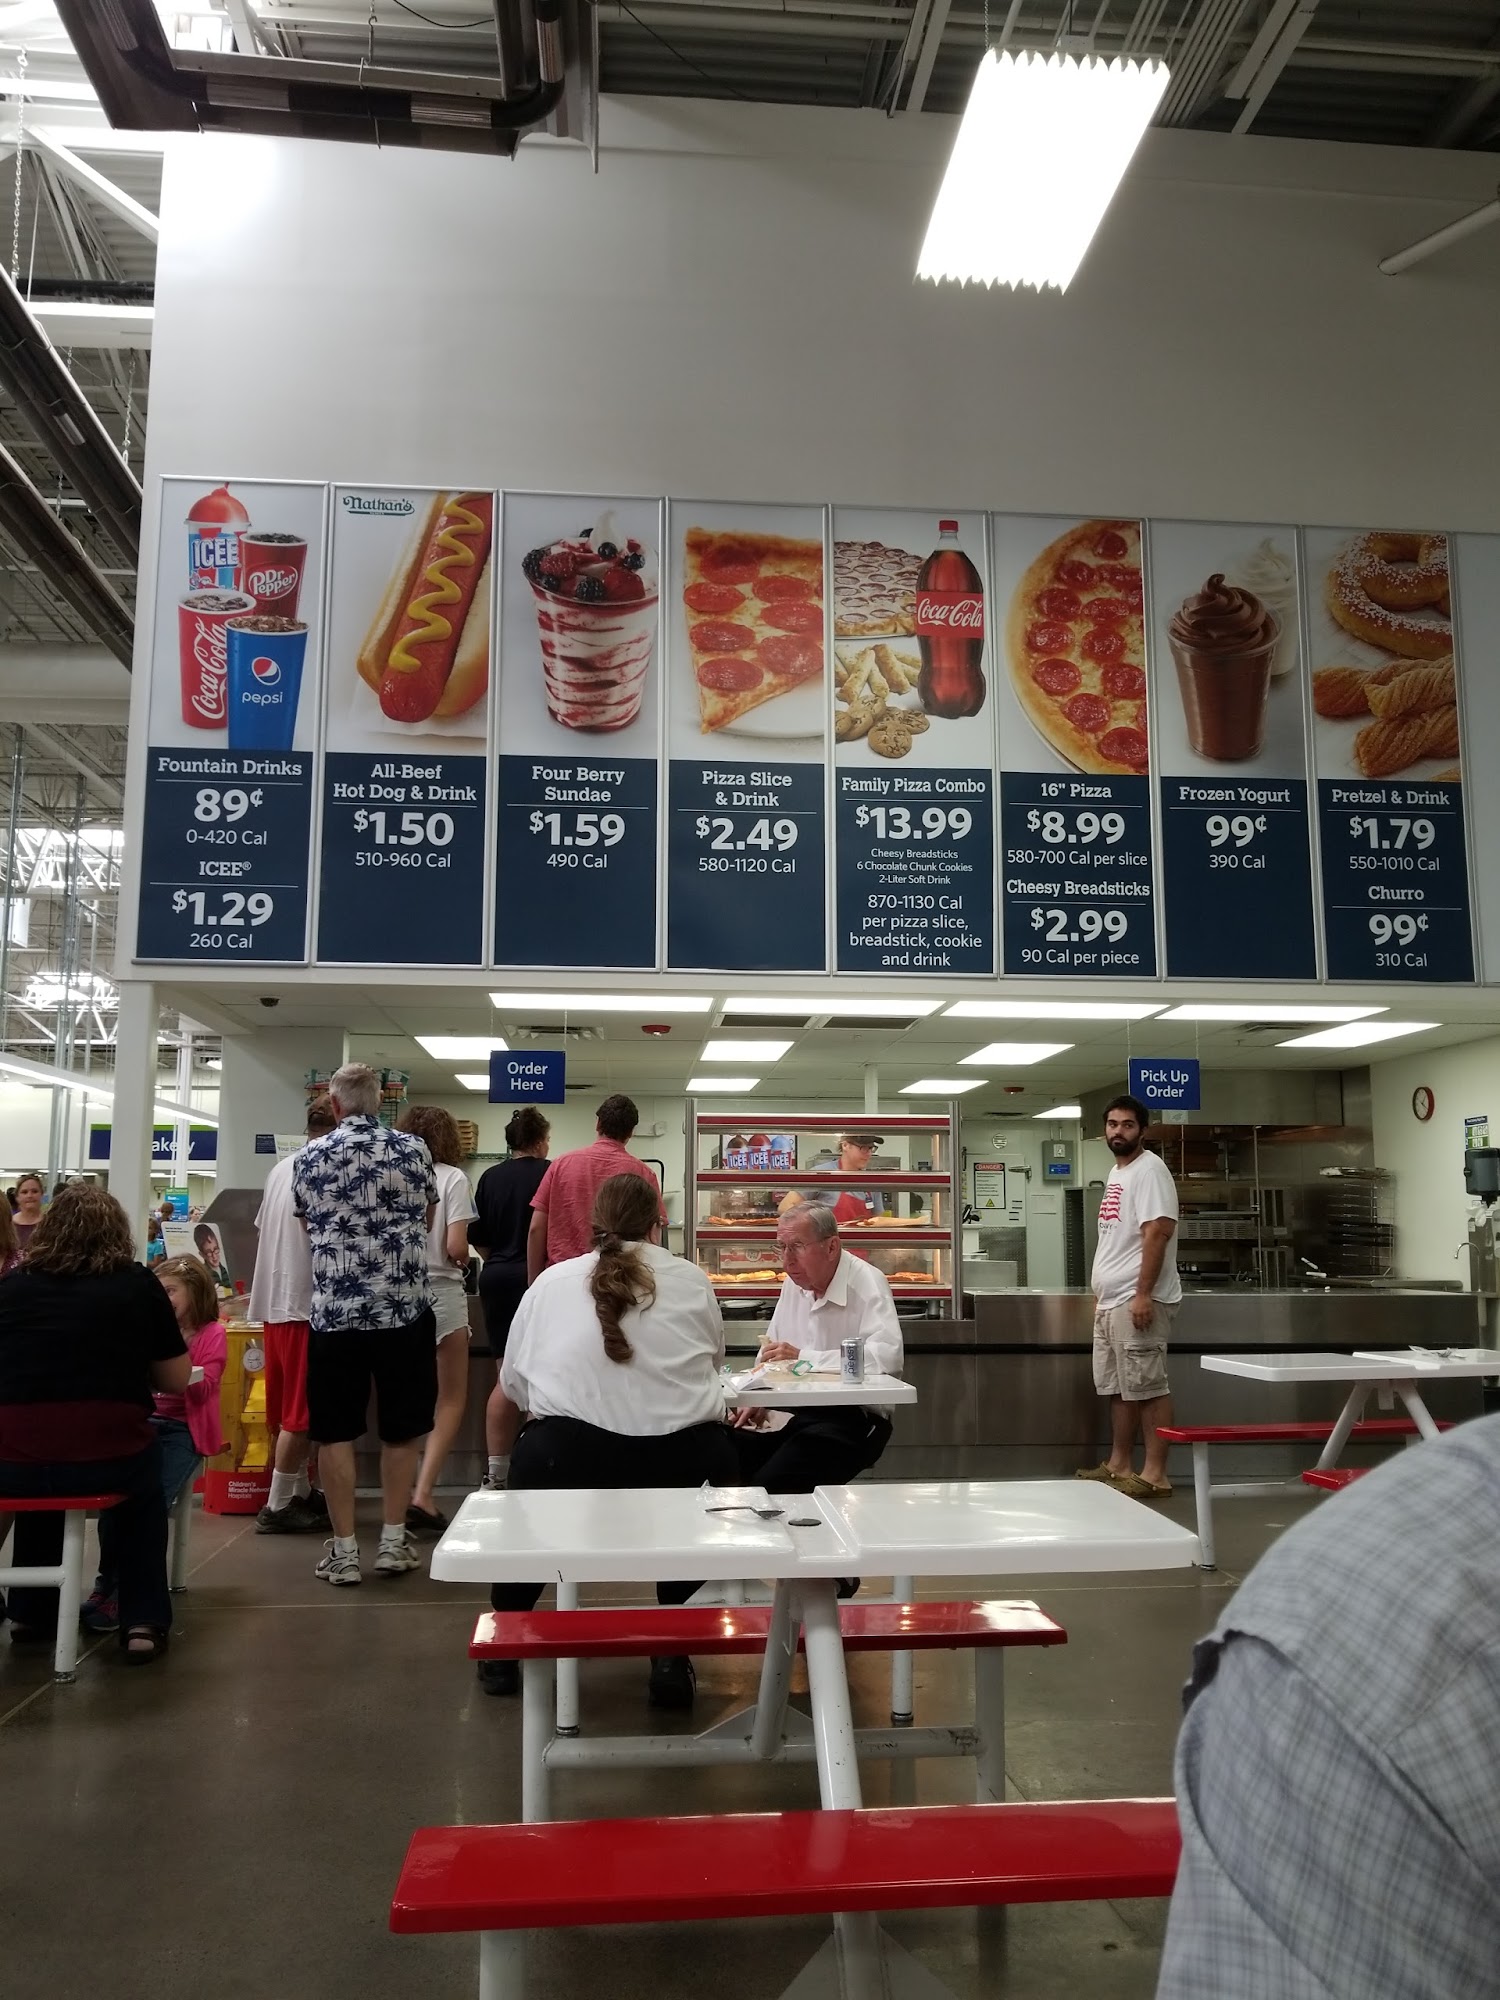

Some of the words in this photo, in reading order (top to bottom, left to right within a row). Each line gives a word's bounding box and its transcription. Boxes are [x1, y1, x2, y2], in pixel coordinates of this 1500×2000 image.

[342, 495, 413, 512] Nathan's
[192, 538, 240, 568] ICEE
[265, 569, 285, 580] Dr
[250, 572, 296, 597] Pepper
[918, 598, 983, 628] Coca-Cola
[242, 691, 283, 706] pepsi
[158, 757, 238, 775] Fountain
[242, 759, 303, 777] Drinks
[370, 763, 442, 779] All-Beef
[532, 766, 572, 782] Four
[576, 767, 625, 786] Berry
[702, 770, 746, 786] Pizza
[750, 771, 793, 787] Slice
[333, 783, 365, 799] Hot
[369, 784, 405, 802] Dog
[410, 785, 423, 799] &
[428, 785, 477, 801] Drink
[544, 786, 612, 802] Sundae
[841, 777, 890, 795] Family
[894, 778, 932, 793] Pizza
[935, 778, 986, 793] Combo
[1040, 782, 1066, 796] 16"
[1070, 783, 1112, 798] Pizza
[715, 791, 728, 806] &
[732, 791, 779, 807] Drink
[1179, 786, 1236, 801] Frozen
[1238, 787, 1291, 805] Yogurt
[1331, 789, 1387, 804] Pretzel
[1390, 790, 1402, 804] &
[1406, 790, 1450, 805] Drink
[193, 788, 264, 823] 89¢
[353, 808, 454, 846] $1.50
[529, 810, 626, 847] $1.59
[855, 804, 972, 841] $13.99
[1026, 809, 1125, 845] $8.99
[1205, 814, 1267, 848] 99¢
[186, 829, 238, 845] 0-420
[241, 830, 267, 846] Cal
[696, 815, 798, 852] $2.49
[1350, 815, 1436, 850] $1.79
[354, 851, 422, 868] 510-960
[426, 852, 451, 868] Cal
[546, 853, 579, 868] 490
[582, 853, 608, 868] Cal
[870, 848, 904, 860] Cheesy
[906, 848, 959, 859] Breadsticks
[1007, 850, 1066, 864] 580-700
[1068, 850, 1091, 865] Cal
[1094, 854, 1115, 868] per
[1118, 851, 1148, 866] slice
[1209, 854, 1239, 868] 390
[1242, 854, 1265, 869] Cal
[698, 857, 767, 873] 580-1120
[771, 858, 796, 873] Cal
[856, 861, 864, 870] 6
[864, 861, 908, 871] Chocolate
[909, 862, 937, 871] Chunk
[938, 862, 973, 872] Cookies
[1349, 856, 1414, 870] 550-1010
[1417, 856, 1440, 871] Cal
[878, 874, 907, 884] 2-Liter
[908, 874, 926, 884] Soft
[927, 875, 951, 884] Drink
[1006, 879, 1061, 898] Cheesy
[1064, 880, 1150, 897] Breadsticks
[1368, 885, 1425, 900] Churro
[172, 888, 274, 927] $1.29
[867, 895, 935, 909] 870-1130
[938, 895, 963, 910] Cal
[862, 917, 887, 931] per
[890, 915, 929, 930] pizza
[932, 914, 969, 930] slice,
[1030, 907, 1128, 943] $2.99
[1368, 913, 1429, 946] 99¢
[189, 933, 223, 949] 260
[226, 933, 253, 949] Cal
[850, 932, 930, 950] breadstick,
[934, 933, 982, 948] cookie
[882, 952, 909, 966] and
[913, 952, 951, 967] drink
[1021, 949, 1042, 964] 90
[1046, 949, 1069, 964] Cal
[1073, 952, 1097, 967] per
[1101, 950, 1140, 967] piece
[1375, 953, 1401, 967] 310
[1404, 953, 1428, 967] Cal
[506, 1061, 548, 1075] Order
[510, 1078, 544, 1091] Here
[1140, 1069, 1168, 1083] Pick
[1170, 1070, 1189, 1085] Up
[1146, 1085, 1184, 1098] Order
[152, 1137, 195, 1154] akey
[728, 1154, 747, 1167] ICEE
[750, 1152, 769, 1165] ICEE
[771, 1154, 790, 1167] ICEE
